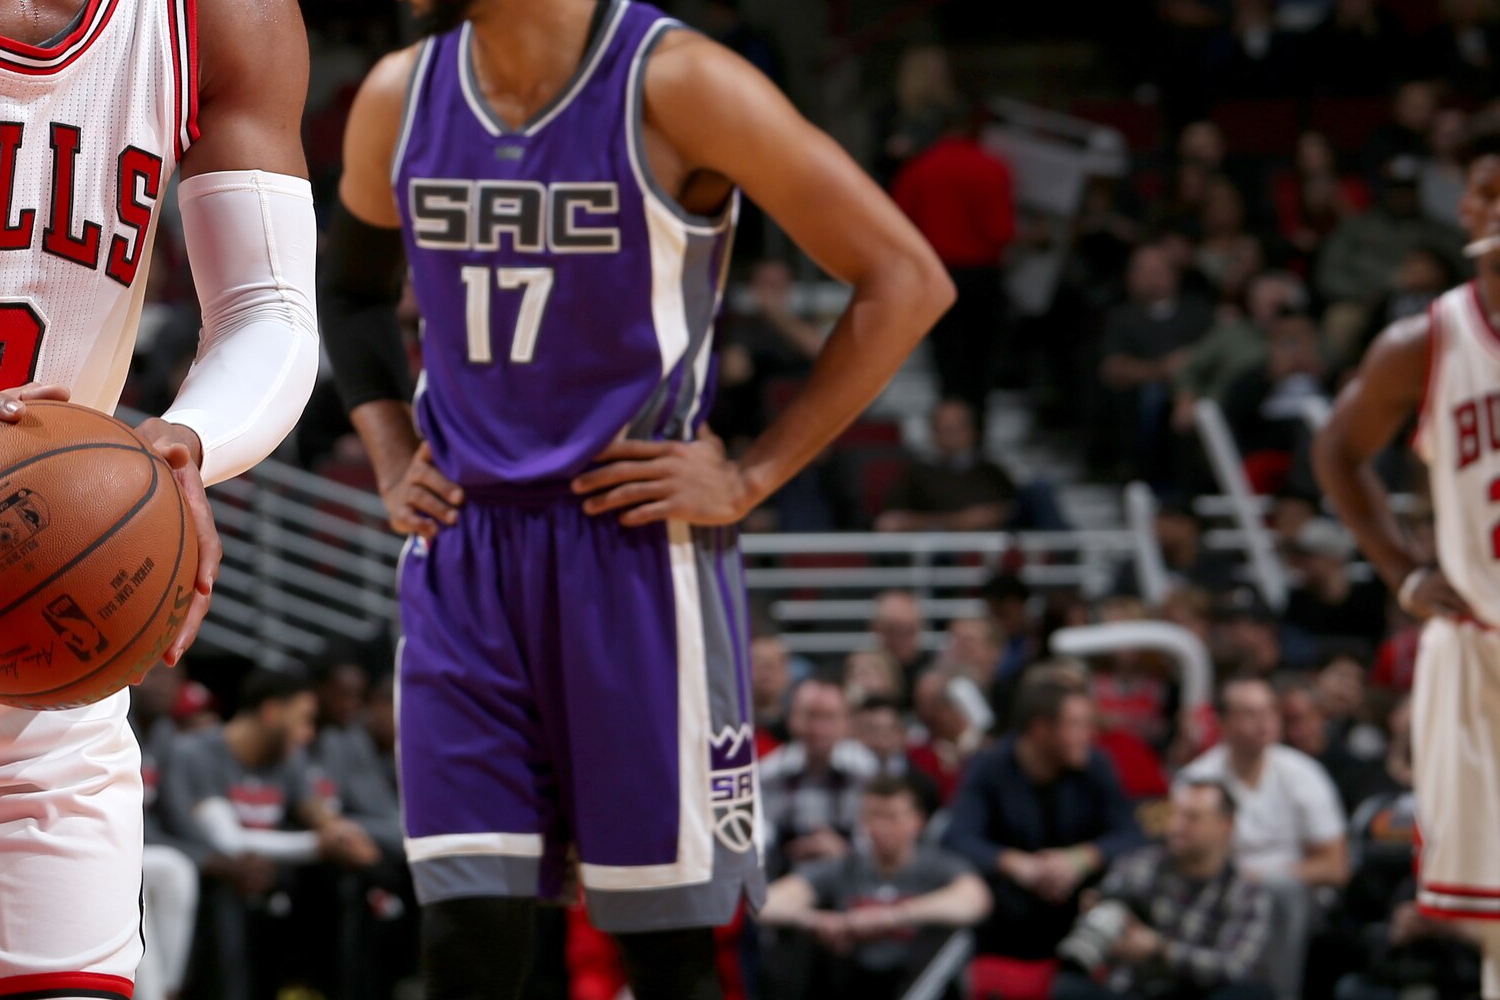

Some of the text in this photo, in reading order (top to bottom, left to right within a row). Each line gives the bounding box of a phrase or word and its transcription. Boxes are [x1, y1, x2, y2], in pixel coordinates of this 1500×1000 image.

[408, 178, 621, 254] SAC
[461, 266, 554, 363] 17
[97, 556, 155, 621] OFFICIAL GAME BALL
